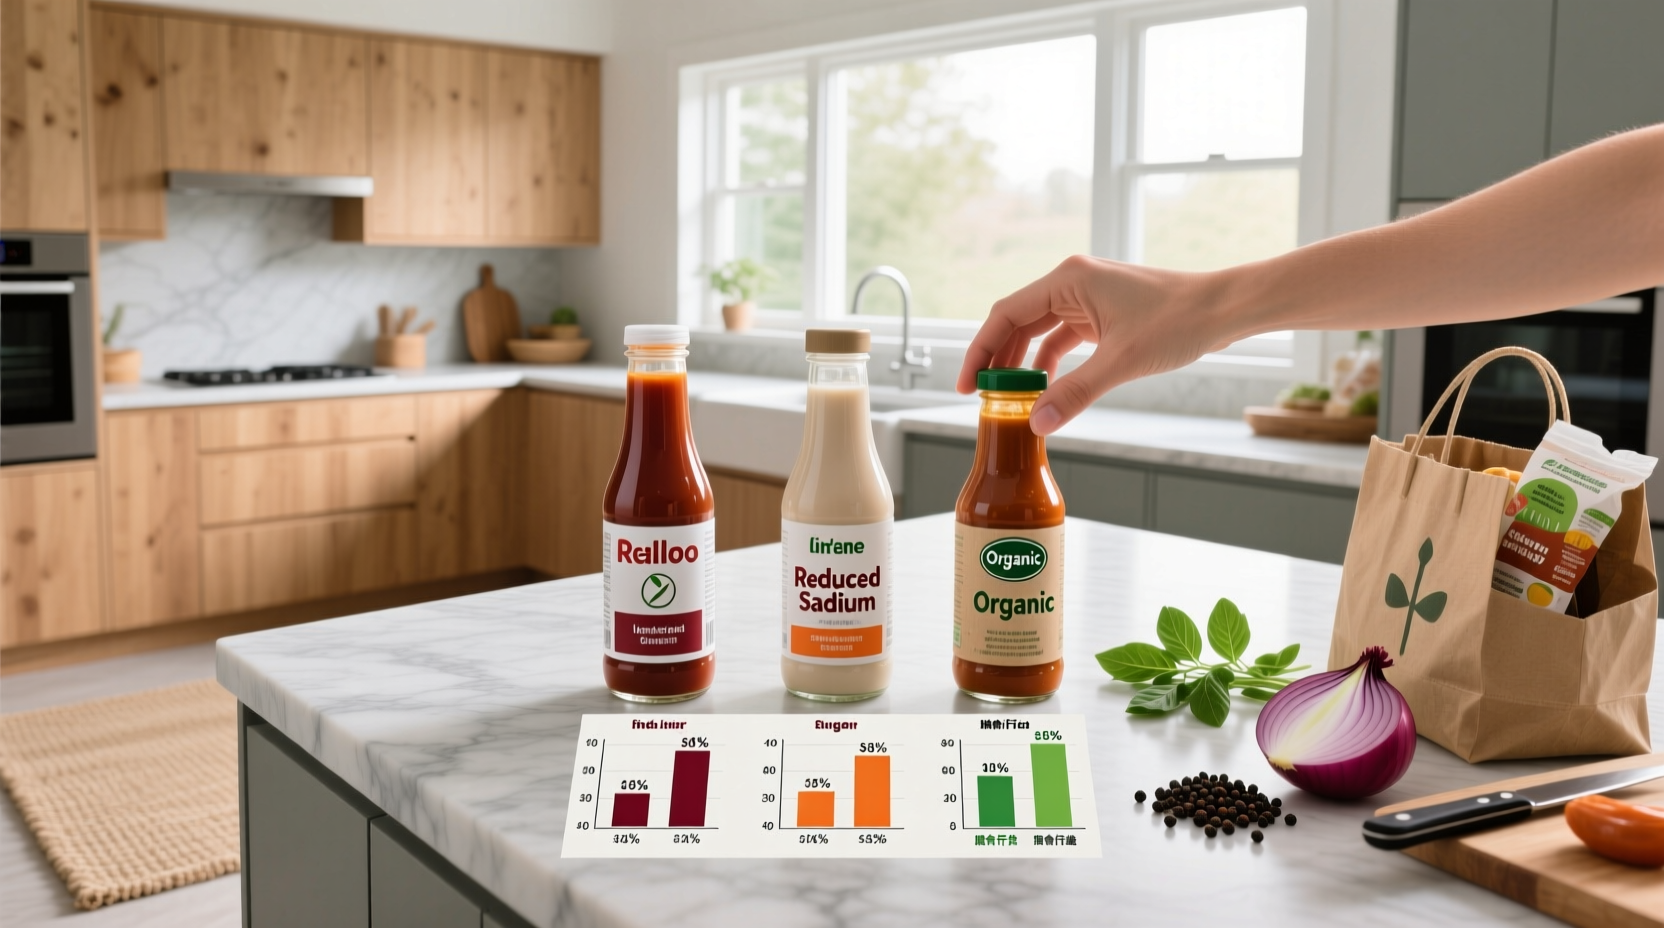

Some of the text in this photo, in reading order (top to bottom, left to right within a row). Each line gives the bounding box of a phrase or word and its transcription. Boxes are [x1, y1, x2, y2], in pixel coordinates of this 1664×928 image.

[986, 550, 1042, 571] Organic
[794, 565, 881, 589] Reduced
[799, 591, 876, 613] Sadium
[973, 590, 1055, 621] Organic
